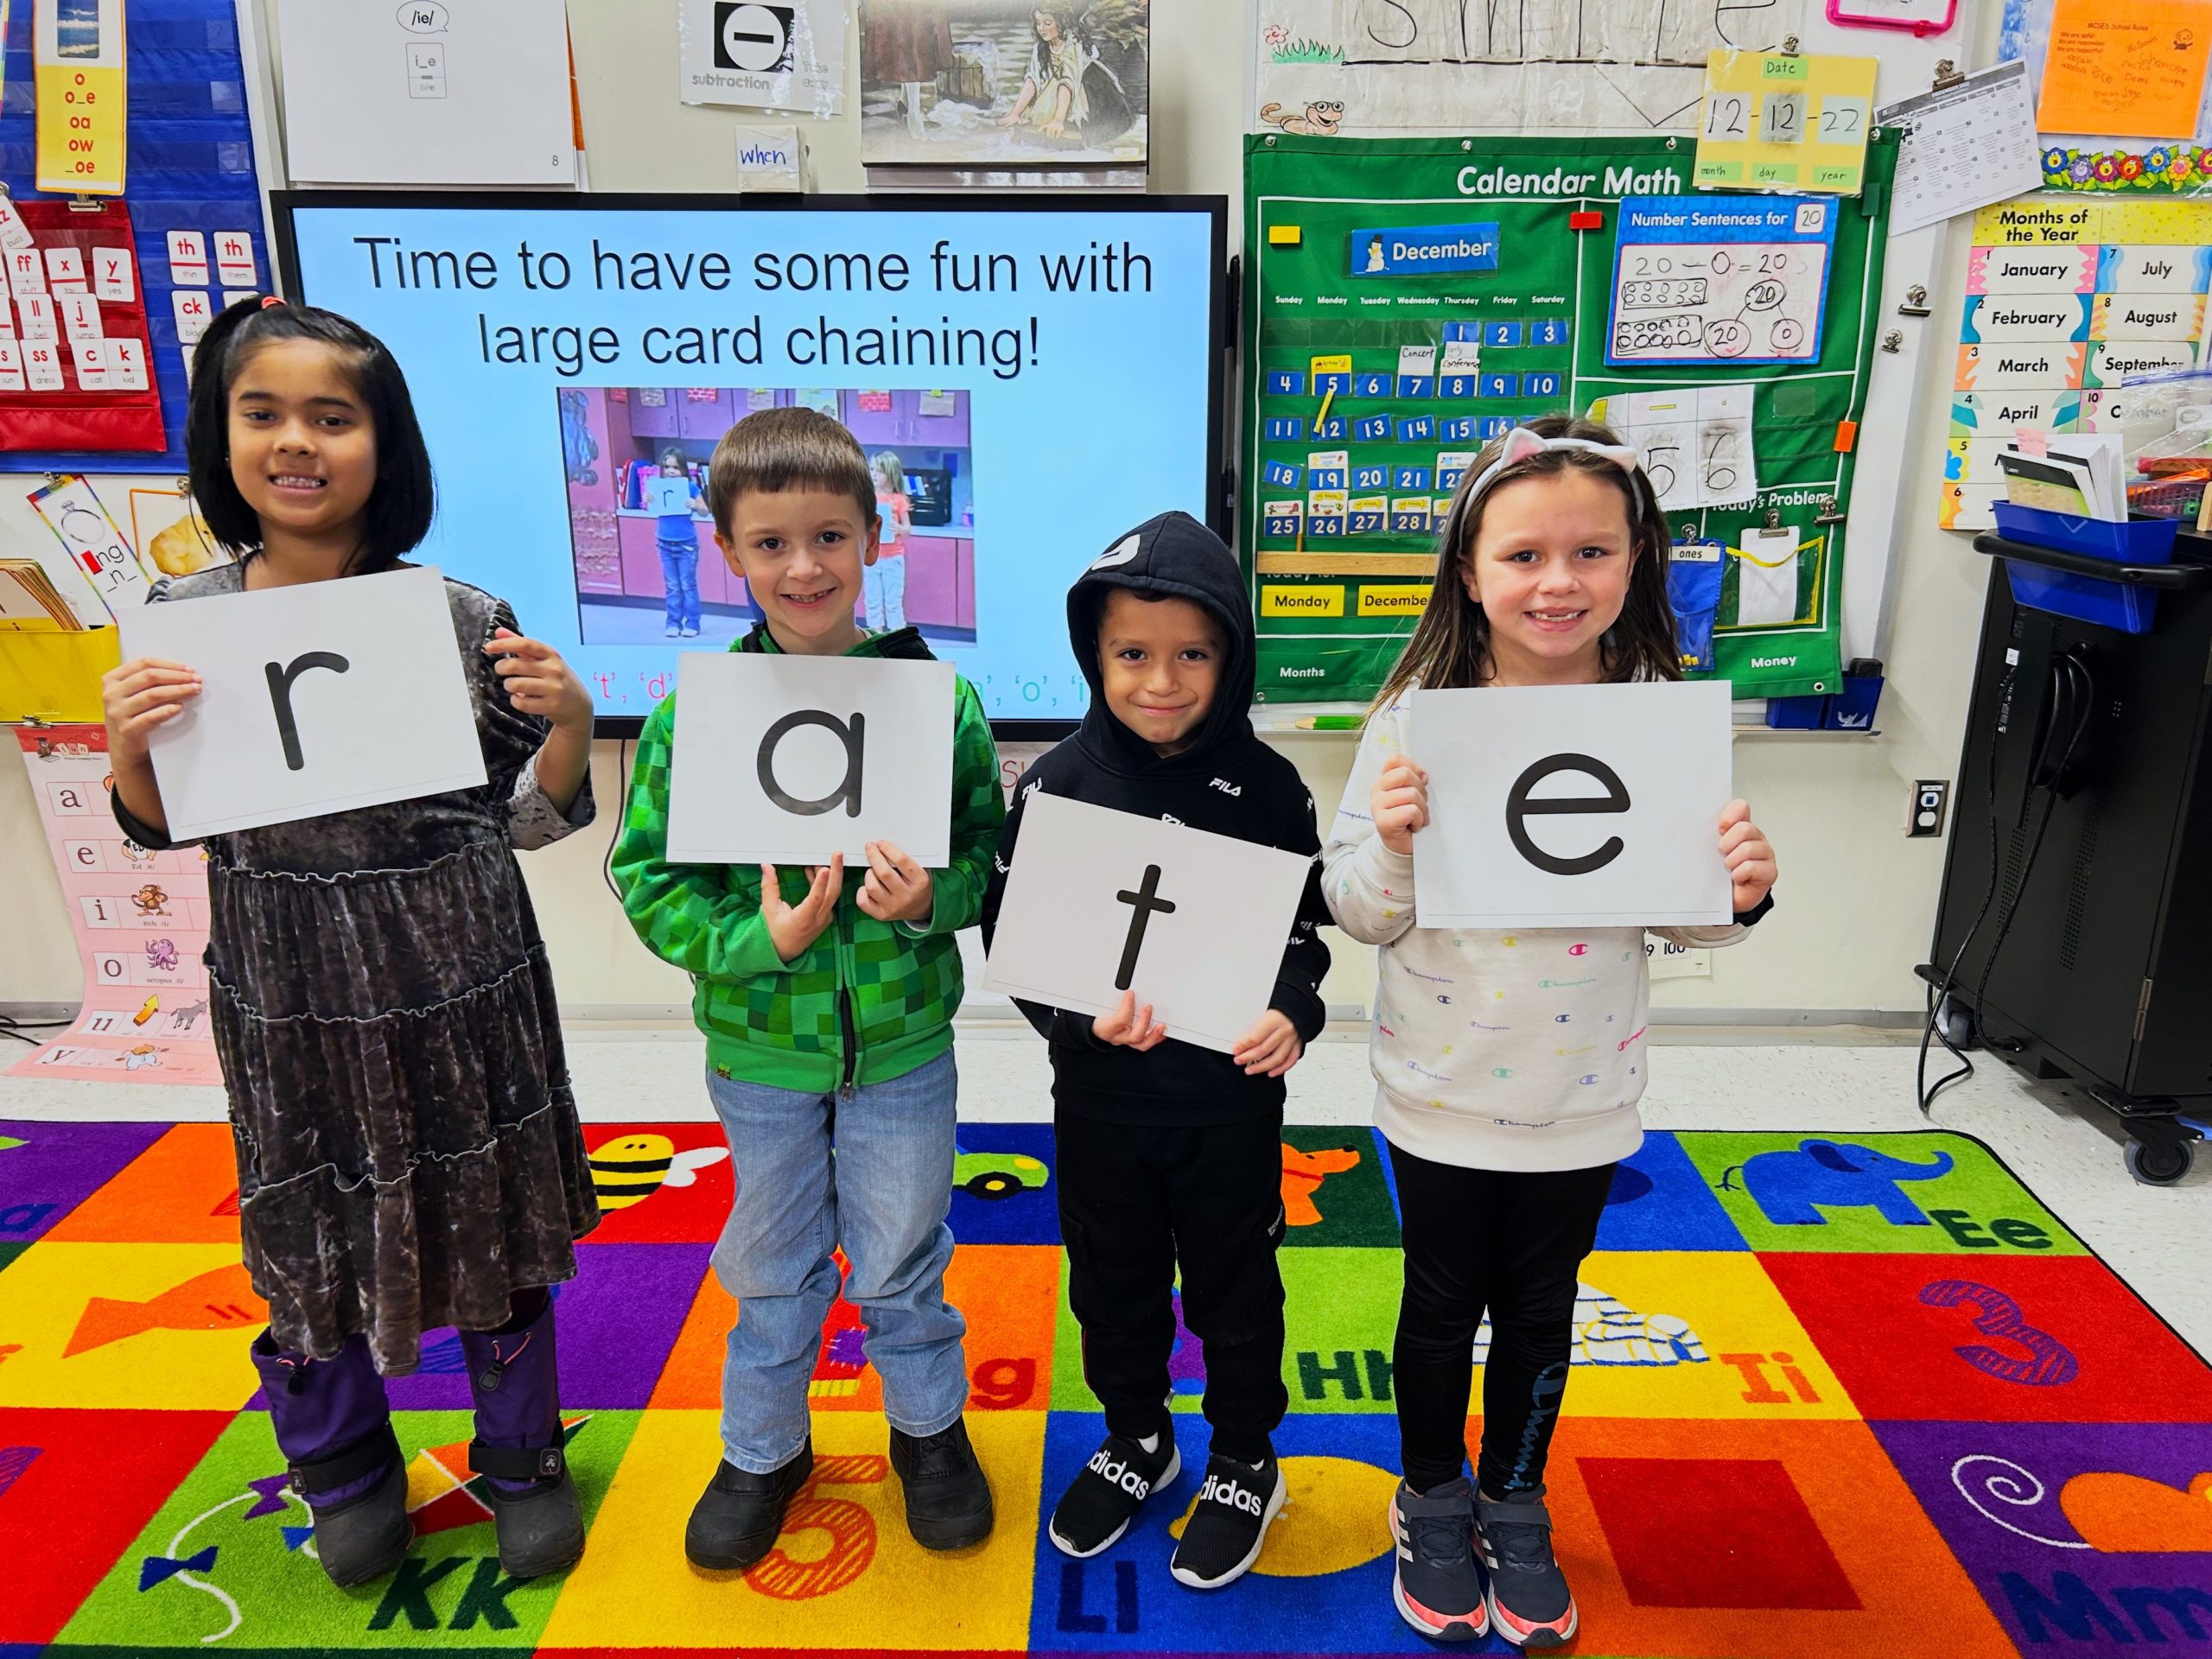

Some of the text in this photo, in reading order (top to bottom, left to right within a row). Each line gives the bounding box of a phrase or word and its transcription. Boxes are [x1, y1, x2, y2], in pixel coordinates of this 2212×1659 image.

[411, 10, 434, 26] /ie/
[1766, 61, 1796, 74] Date
[75, 73, 85, 86] o
[692, 73, 770, 90] subtraction
[69, 116, 91, 129] oa
[1707, 99, 1859, 133] 12 12 22
[68, 139, 93, 152] ow
[740, 143, 786, 165] when
[551, 155, 559, 167] 8
[1457, 167, 1681, 195] Calendar Math
[1700, 167, 1846, 181] month day year
[1631, 212, 1788, 226] Number Sentences for
[1802, 209, 1821, 227] 20
[1999, 208, 2088, 226] Months of
[2006, 228, 2079, 242] the Year
[177, 238, 243, 256] th th
[1392, 238, 1492, 261] December
[16, 255, 32, 272] ff
[60, 260, 70, 271] x
[107, 260, 118, 277] y
[353, 237, 1153, 292] Time to have some fun with
[1636, 257, 1672, 276] 20
[1758, 253, 1788, 274] 20
[1986, 251, 2068, 280] 1 January
[2109, 249, 2172, 279] 7 July
[108, 287, 122, 296] yes
[1274, 294, 1565, 306] Sunday Monday Tuesday Wednesday Thursday Friday Saturday
[1753, 284, 1776, 304] 20
[76, 301, 84, 322] j
[182, 297, 202, 315] ck
[1976, 299, 2067, 327] 2 February
[2104, 297, 2177, 327] 8 August
[1458, 326, 1554, 342] 1 2 3
[1713, 327, 1738, 346] 20
[1, 344, 130, 362] s ss c k
[479, 314, 1039, 380] large card chaining!
[1402, 346, 1436, 359] Concert
[2098, 344, 2105, 354] 9
[1971, 347, 2049, 373] 3 March
[36, 376, 55, 385] dress
[1280, 376, 1554, 395] 4 5 6 7 8 9 10
[2088, 393, 2099, 403] 10
[1964, 394, 2038, 424] 4 April
[1274, 422, 1293, 436] 11
[1321, 421, 1339, 438] 12
[1364, 420, 1385, 437] 13
[1408, 421, 1427, 438] 14
[1450, 422, 1470, 438] 15
[1960, 442, 1967, 452] 5
[1647, 432, 1737, 499] 5 6
[1273, 467, 1421, 488] 18 19 20 21
[1953, 487, 1961, 498] 6
[1272, 515, 1420, 534] 25 26 27 28
[1679, 549, 1702, 560] ones
[1274, 594, 1427, 610] Monday Decembe
[1751, 655, 1797, 670] Money
[1279, 667, 1325, 677] Months
[265, 650, 348, 770] r
[757, 710, 865, 818] a
[1209, 778, 1242, 797] FILA
[60, 789, 82, 808] a
[1506, 753, 1630, 874] e
[77, 846, 95, 864] e
[95, 899, 107, 921] i
[1115, 864, 1176, 990] t
[1663, 942, 1686, 955] 100
[104, 958, 122, 977] o
[1403, 966, 1455, 983] Champion
[1538, 977, 1597, 988] Champion
[92, 1018, 120, 1031] u
[1470, 1020, 1511, 1031] Champion
[41, 1048, 73, 1065] y
[1407, 1060, 1452, 1081] Champion
[1492, 1118, 1555, 1129] Champion
[1928, 1210, 2053, 1249] Ee
[1917, 1279, 2080, 1387] 3
[1719, 1351, 1822, 1404] Ii
[1086, 1449, 1149, 1501] didas
[1199, 1474, 1262, 1516] didas
[759, 1454, 889, 1600] 5
